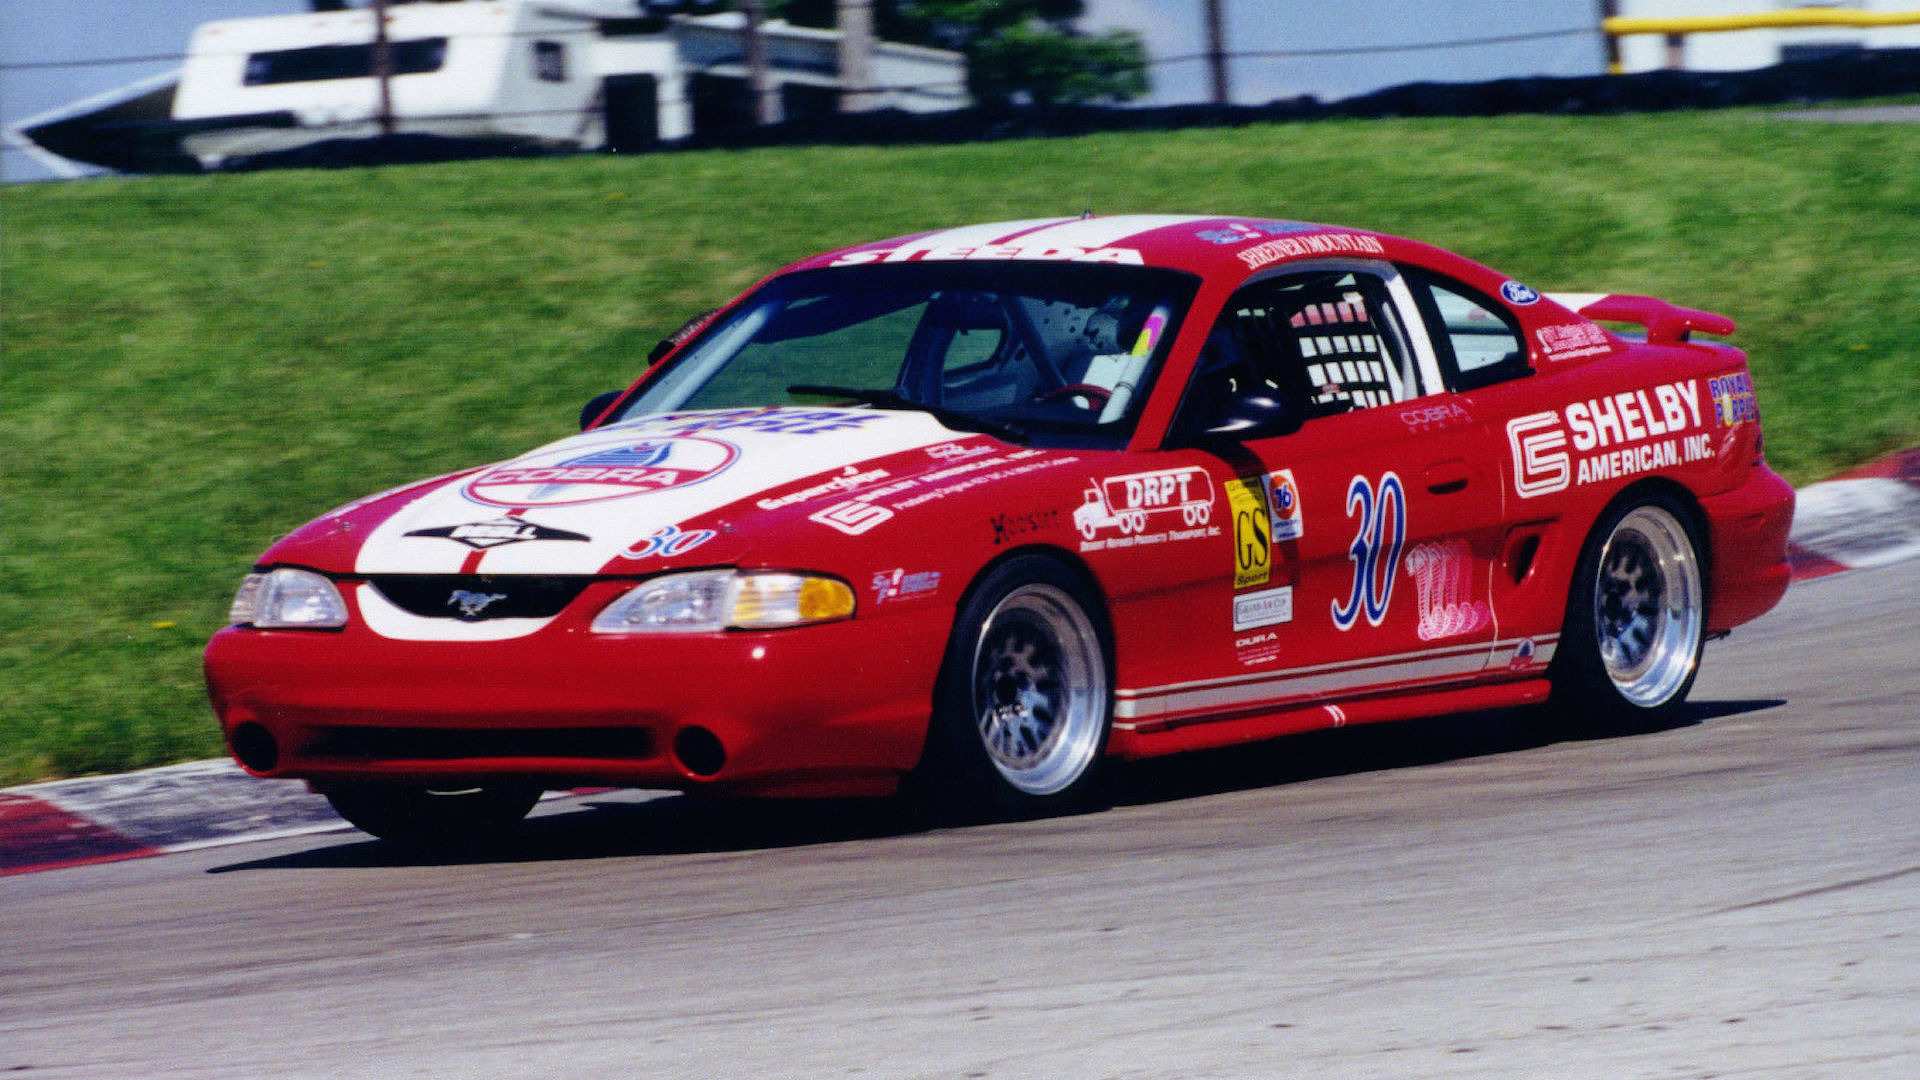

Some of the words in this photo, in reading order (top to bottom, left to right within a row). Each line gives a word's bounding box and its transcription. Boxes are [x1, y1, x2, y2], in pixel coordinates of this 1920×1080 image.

[1400, 403, 1467, 425] COBRA
[1565, 379, 1701, 450] SHELBY
[485, 467, 678, 486] COBRA
[1577, 440, 1682, 485] AMERICAN,
[1683, 433, 1715, 463] INC.
[1126, 474, 1192, 508] DRPT
[1273, 484, 1292, 509] 76
[621, 524, 717, 559] 30
[1237, 507, 1268, 570] GS
[1331, 471, 1406, 631] 30
